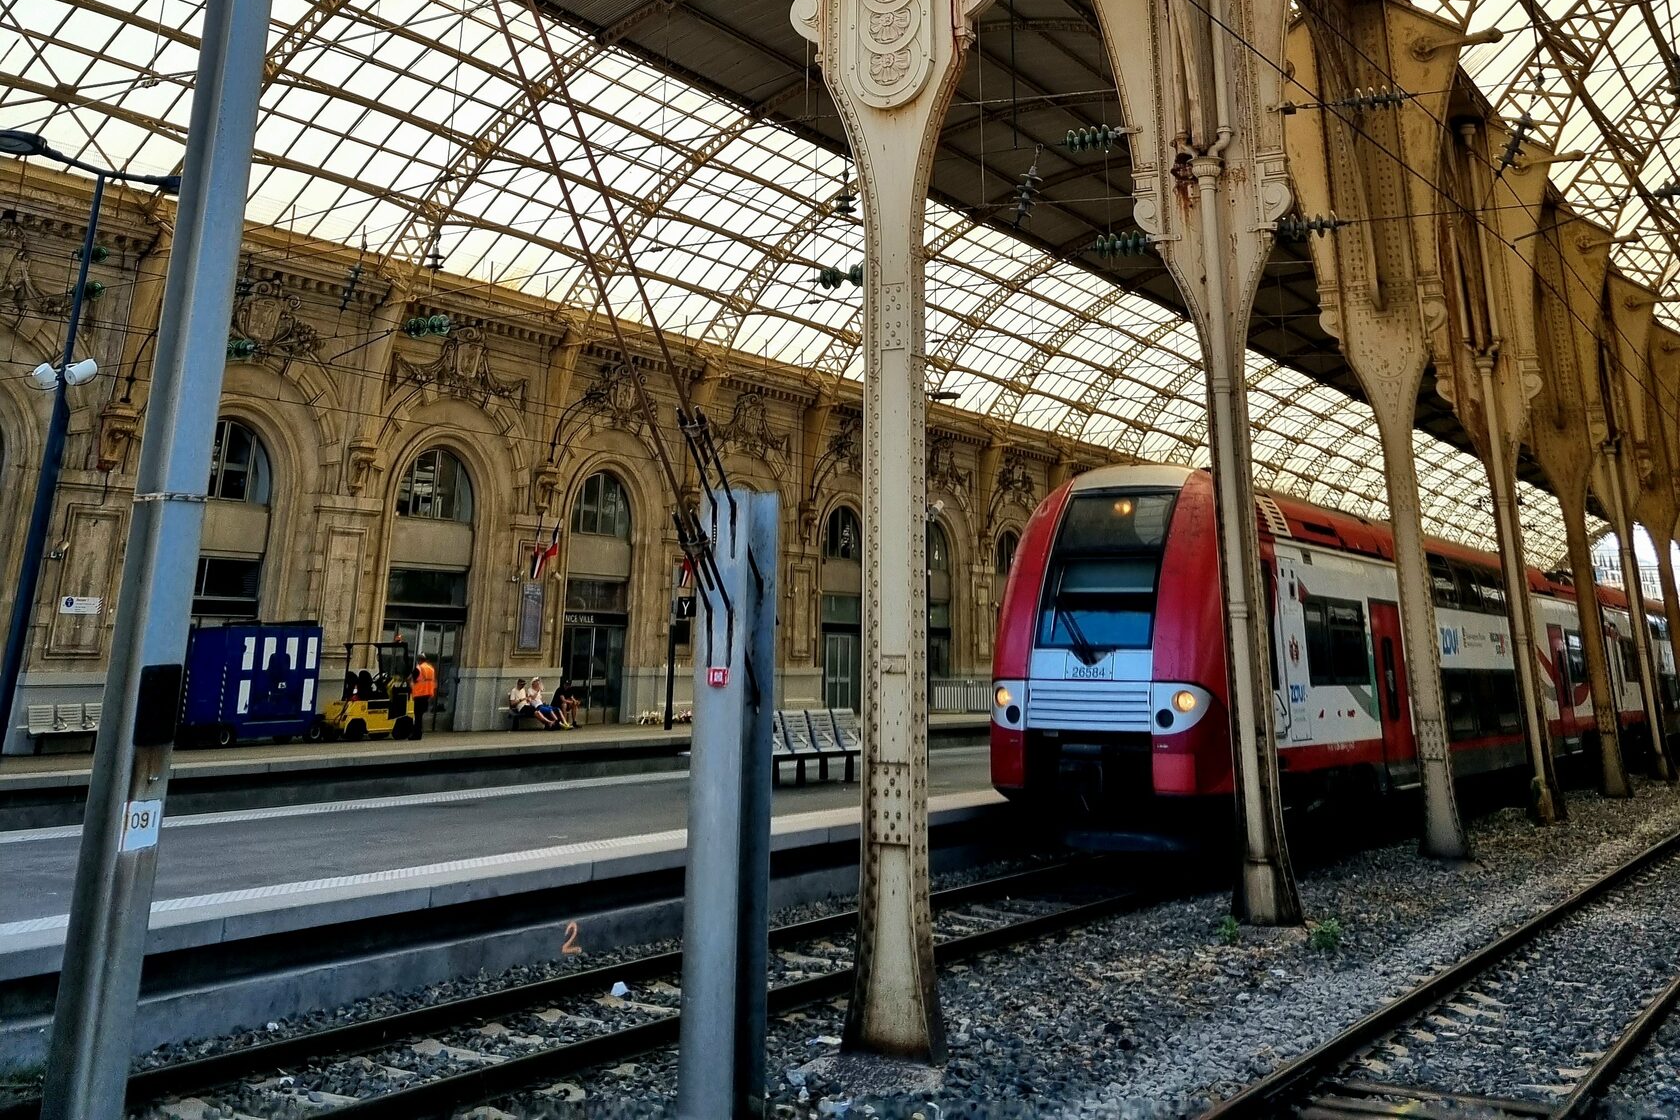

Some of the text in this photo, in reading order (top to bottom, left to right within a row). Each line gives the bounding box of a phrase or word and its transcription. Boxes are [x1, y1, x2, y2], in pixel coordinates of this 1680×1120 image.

[682, 601, 690, 615] Y
[1072, 666, 1105, 678] 26584
[562, 921, 582, 954] 2
